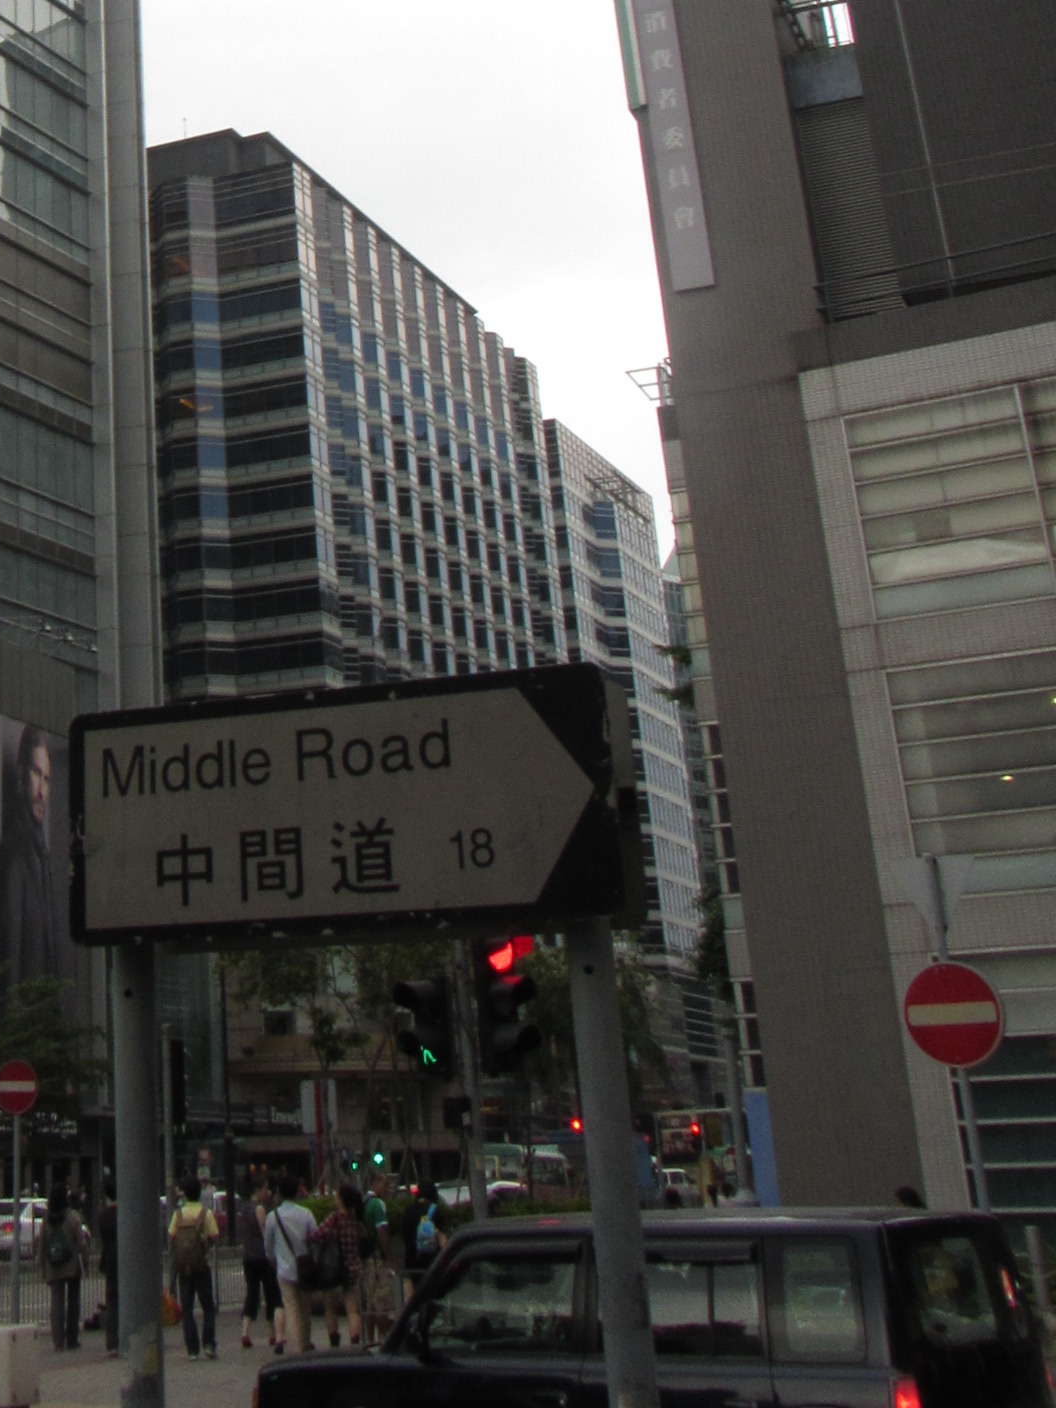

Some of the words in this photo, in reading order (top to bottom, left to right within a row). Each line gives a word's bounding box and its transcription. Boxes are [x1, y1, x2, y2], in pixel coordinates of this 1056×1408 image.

[101, 741, 272, 798] Middle
[296, 718, 451, 782] Road
[155, 817, 400, 907] 中間道
[450, 828, 496, 870] 18
